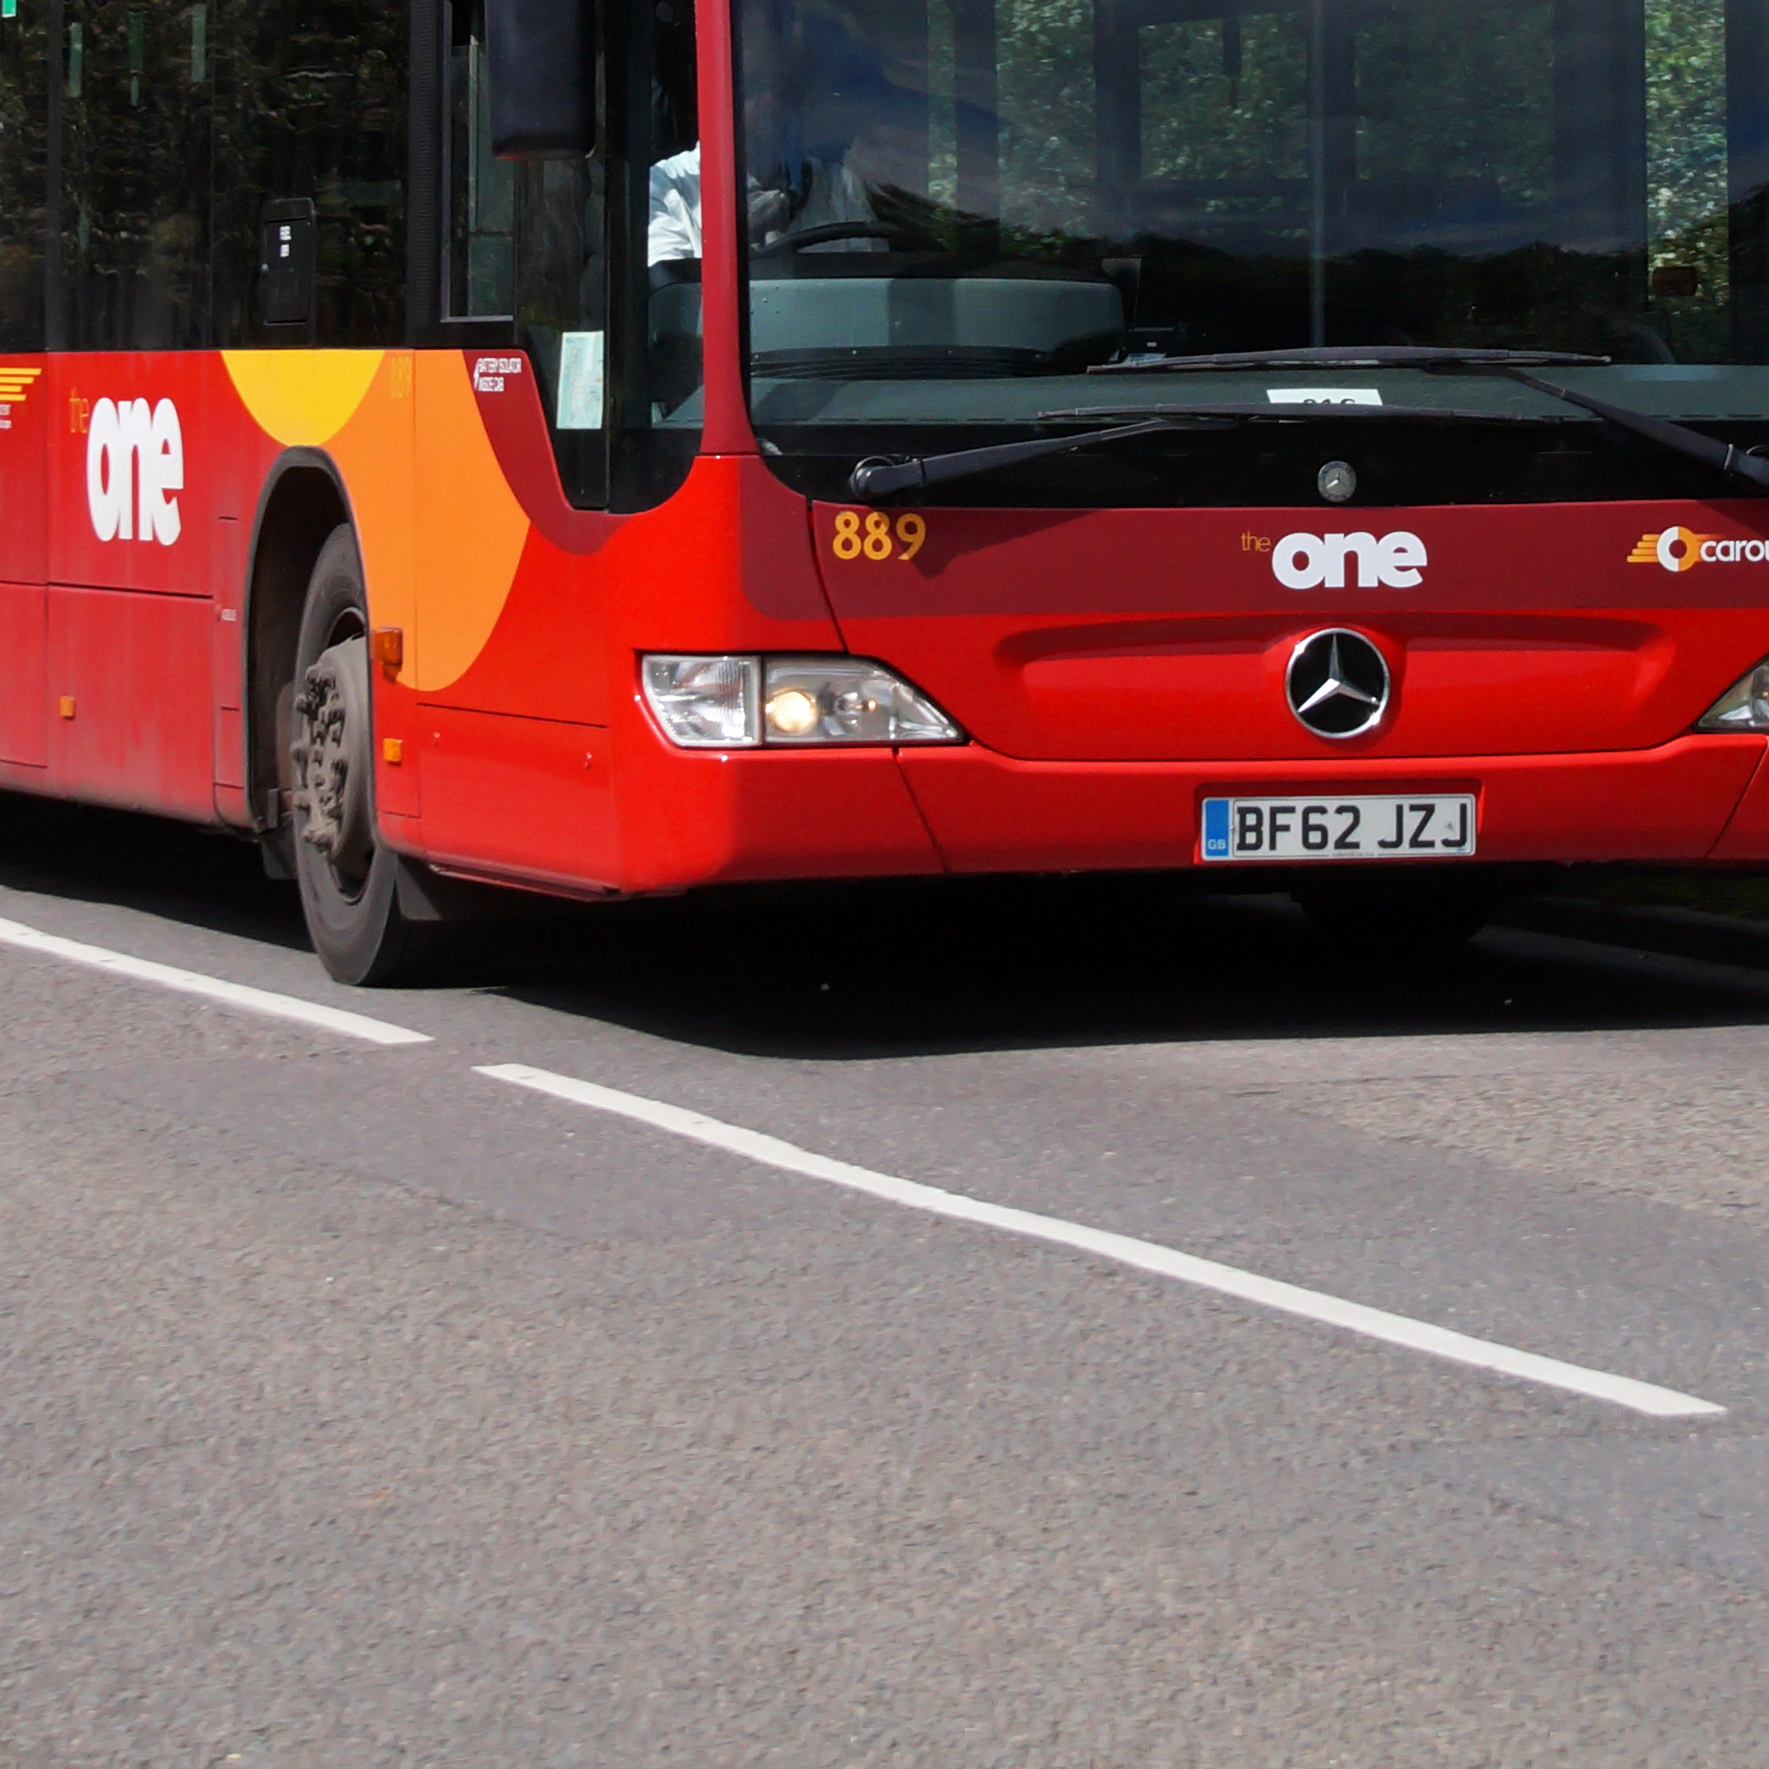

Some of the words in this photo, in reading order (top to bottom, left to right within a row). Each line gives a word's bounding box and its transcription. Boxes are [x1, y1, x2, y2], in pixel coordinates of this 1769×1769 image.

[86, 396, 184, 547] one
[833, 510, 927, 561] 889
[1240, 531, 1272, 553] the
[1271, 530, 1428, 590] one
[1207, 838, 1226, 851] GB
[1236, 804, 1362, 851] BF62
[1377, 803, 1469, 849] JZJ
